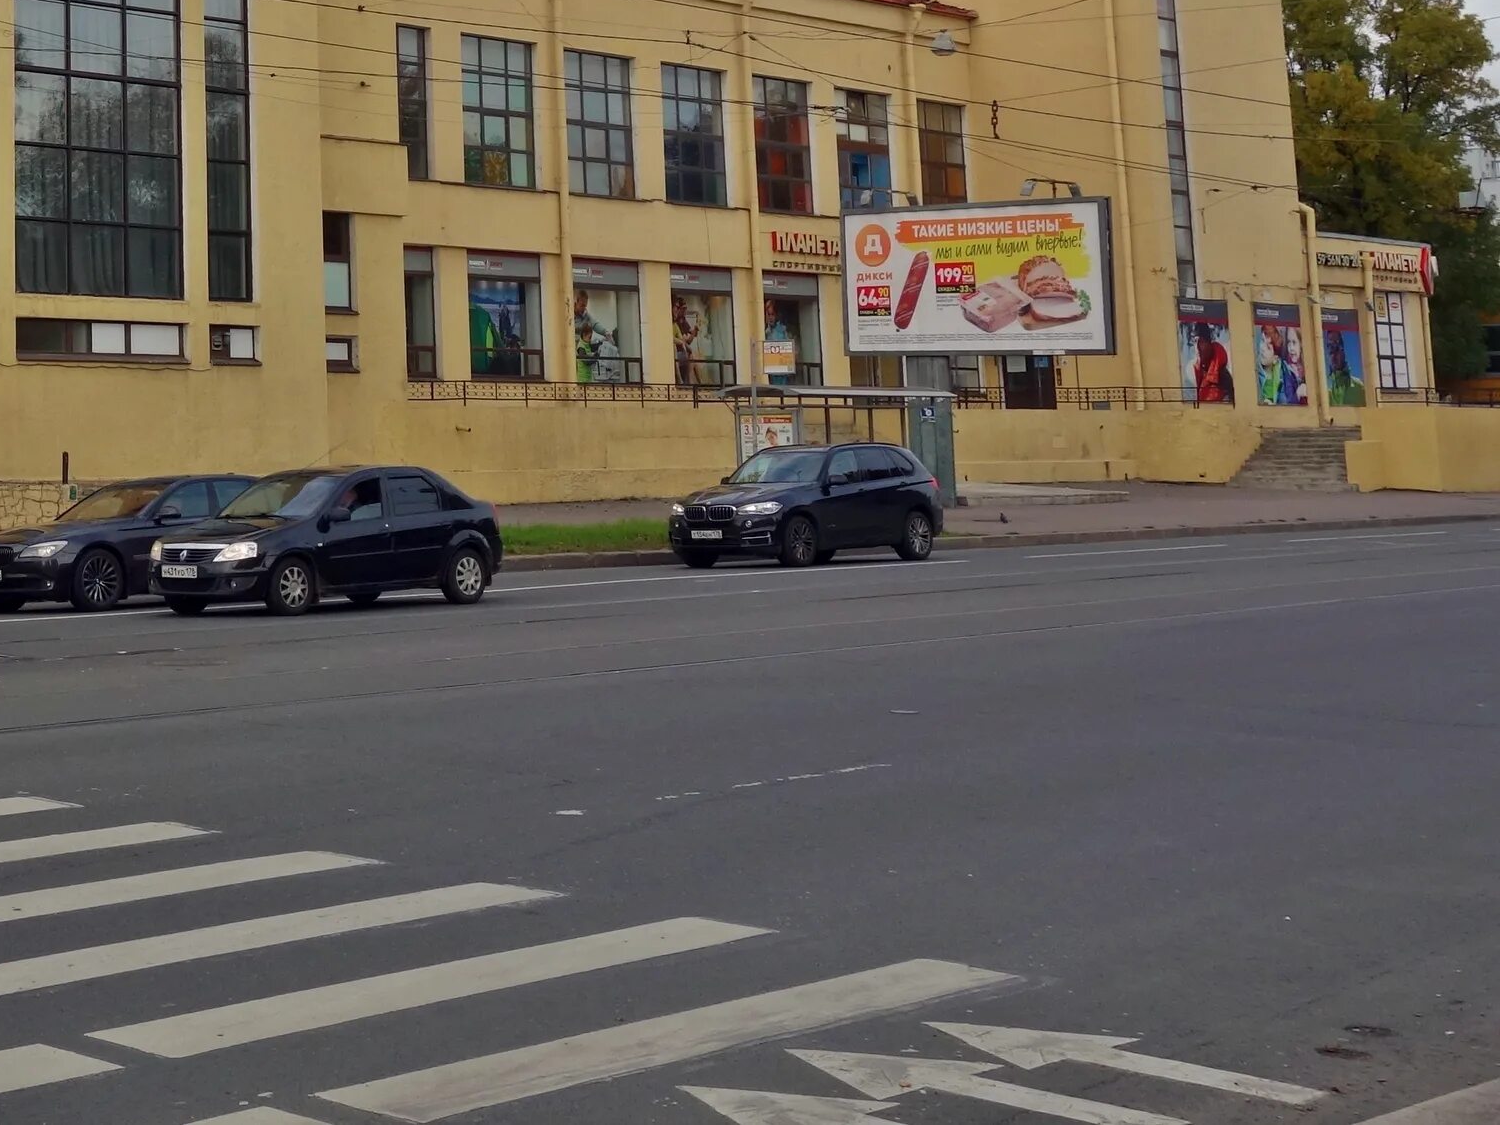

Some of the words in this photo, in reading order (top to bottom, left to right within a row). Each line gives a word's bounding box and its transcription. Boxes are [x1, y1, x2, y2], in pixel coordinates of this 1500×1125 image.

[912, 224, 954, 238] ТАКИЕ
[958, 221, 1012, 236] НИЗКИЕ
[773, 232, 840, 256] ПЛАНЕТА
[936, 248, 952, 259] мы
[955, 246, 962, 256] и
[965, 243, 992, 256] сами
[996, 238, 1029, 257] видим
[1035, 229, 1082, 252] впервые!
[1374, 251, 1419, 273] ПЛАНЕТА
[857, 272, 893, 283] ДИКСИ
[937, 267, 961, 283] 199
[859, 289, 878, 306] 64
